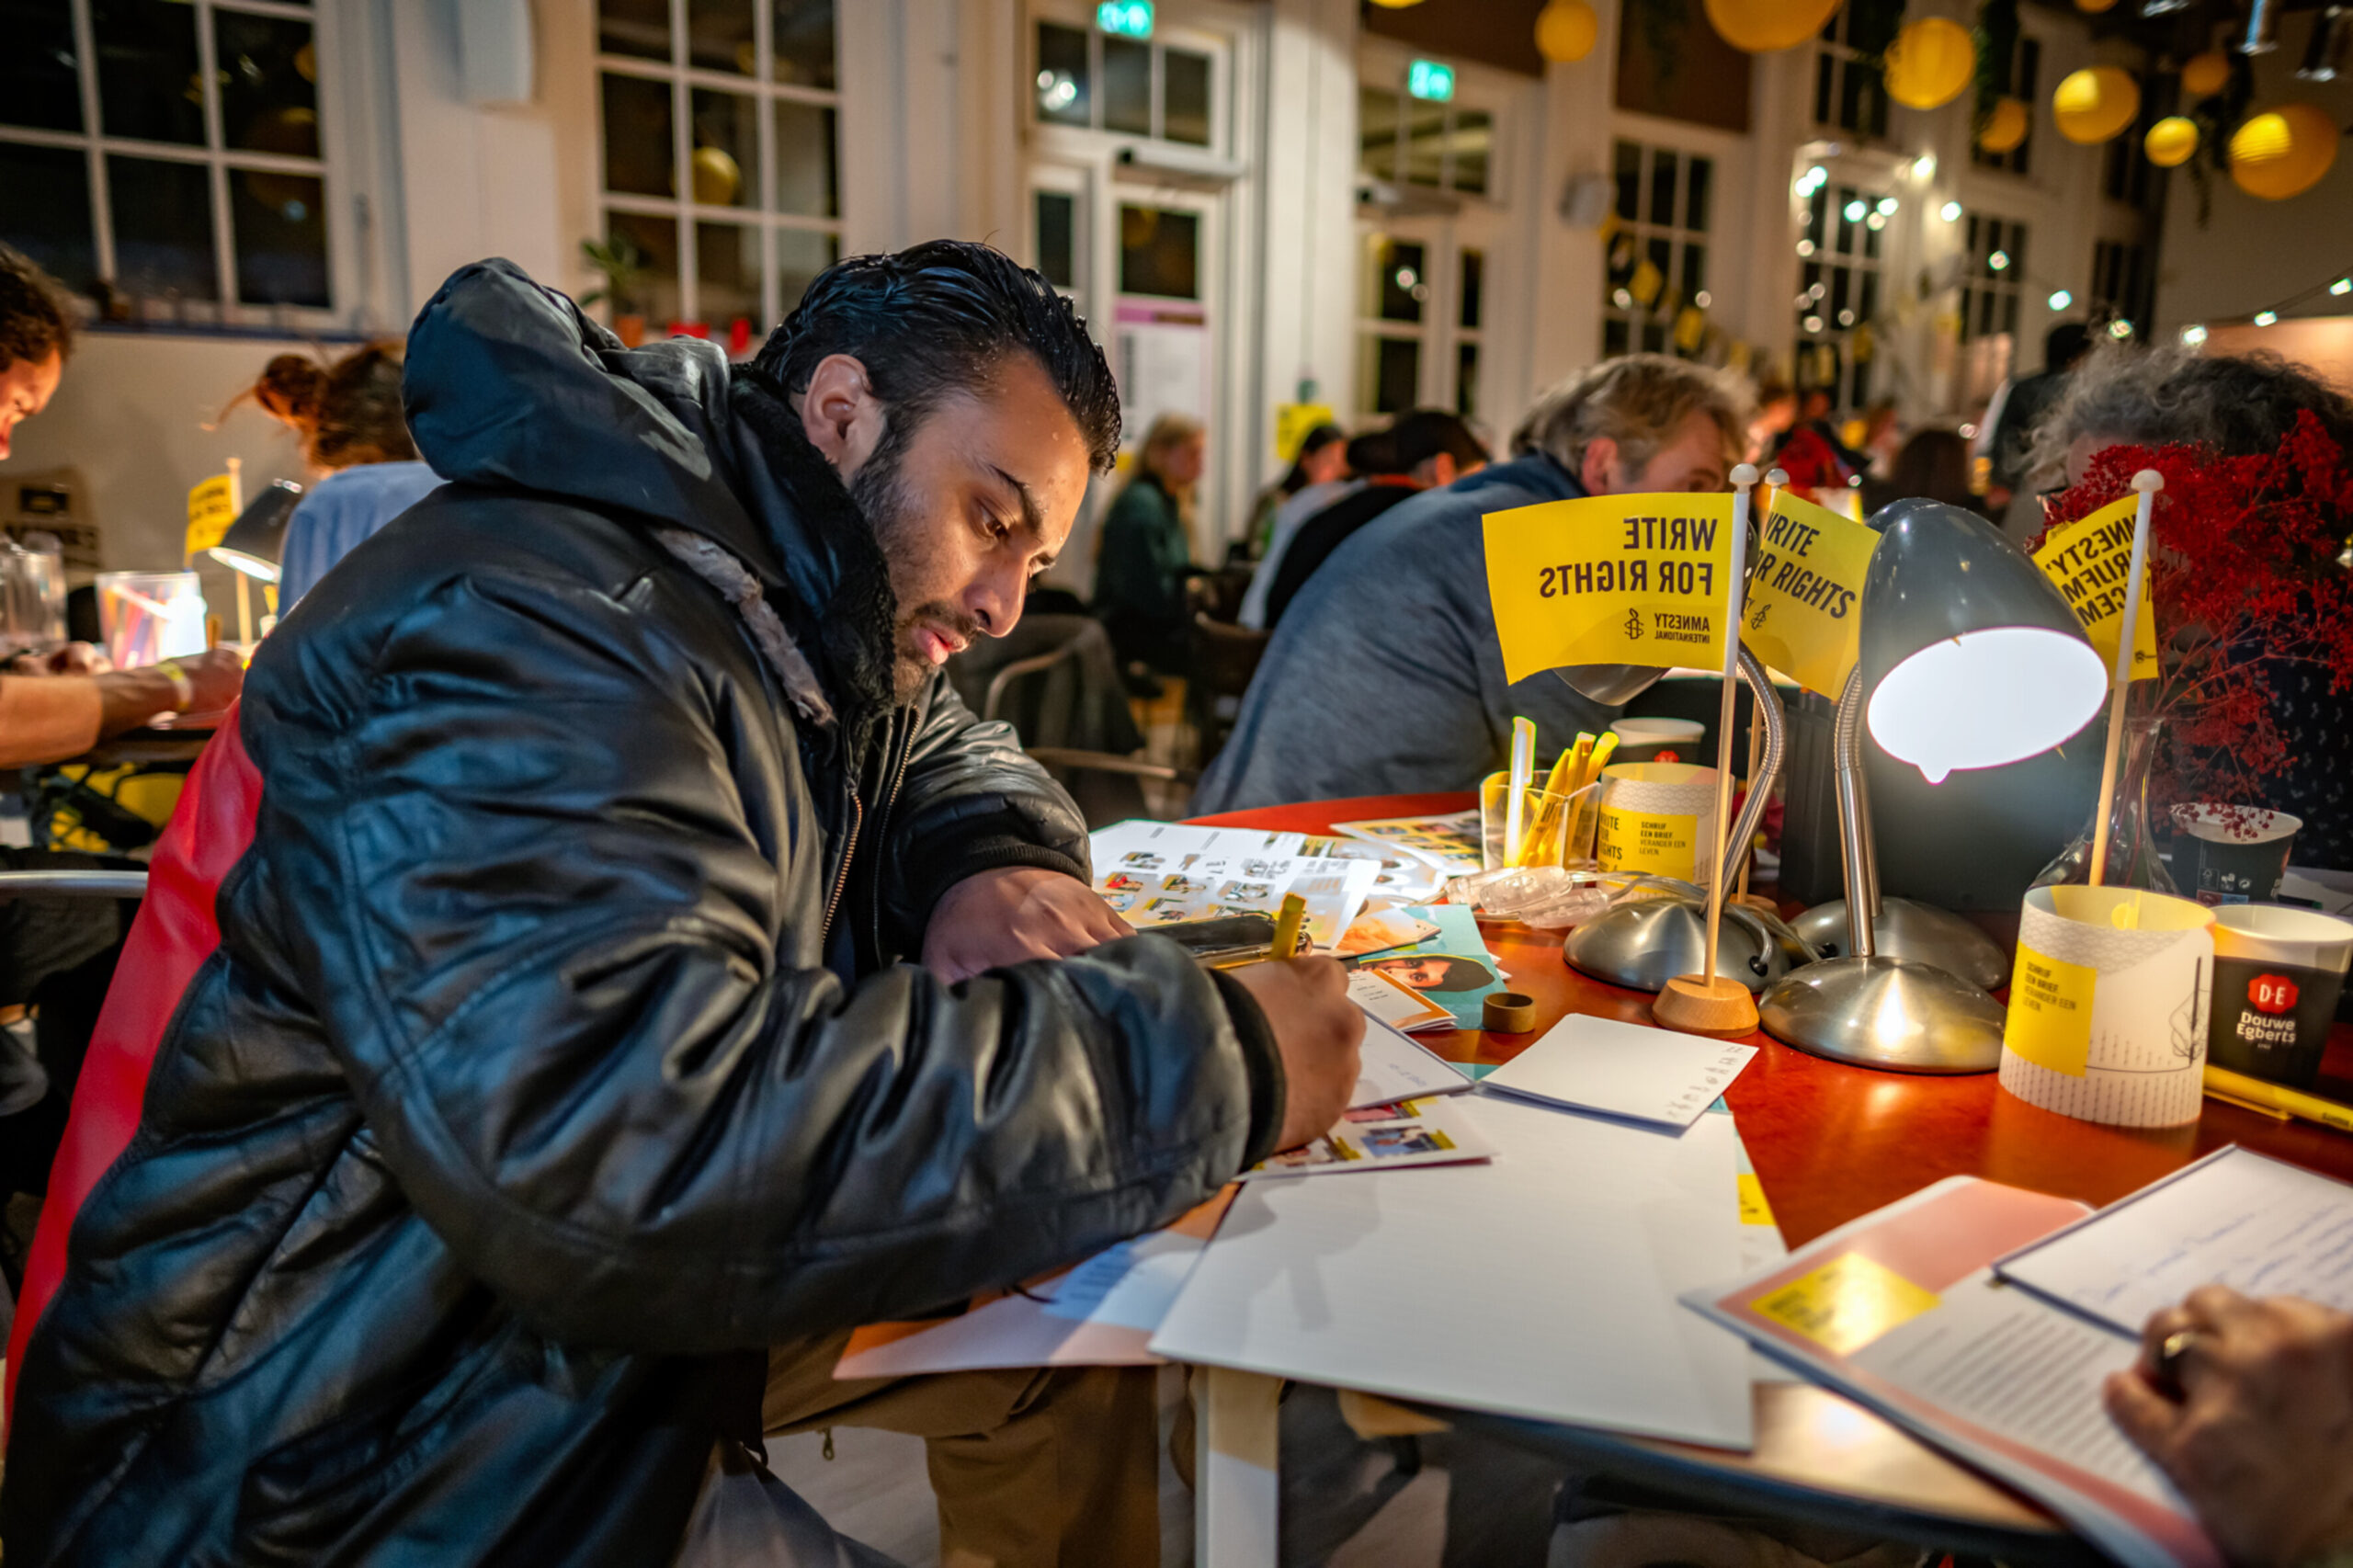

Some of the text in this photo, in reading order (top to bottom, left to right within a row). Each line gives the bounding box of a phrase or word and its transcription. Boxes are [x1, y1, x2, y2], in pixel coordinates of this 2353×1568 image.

[1772, 561, 1857, 619] RIGHTS
[2241, 1011, 2295, 1030] Douwe
[2236, 1023, 2296, 1043] Egberts
